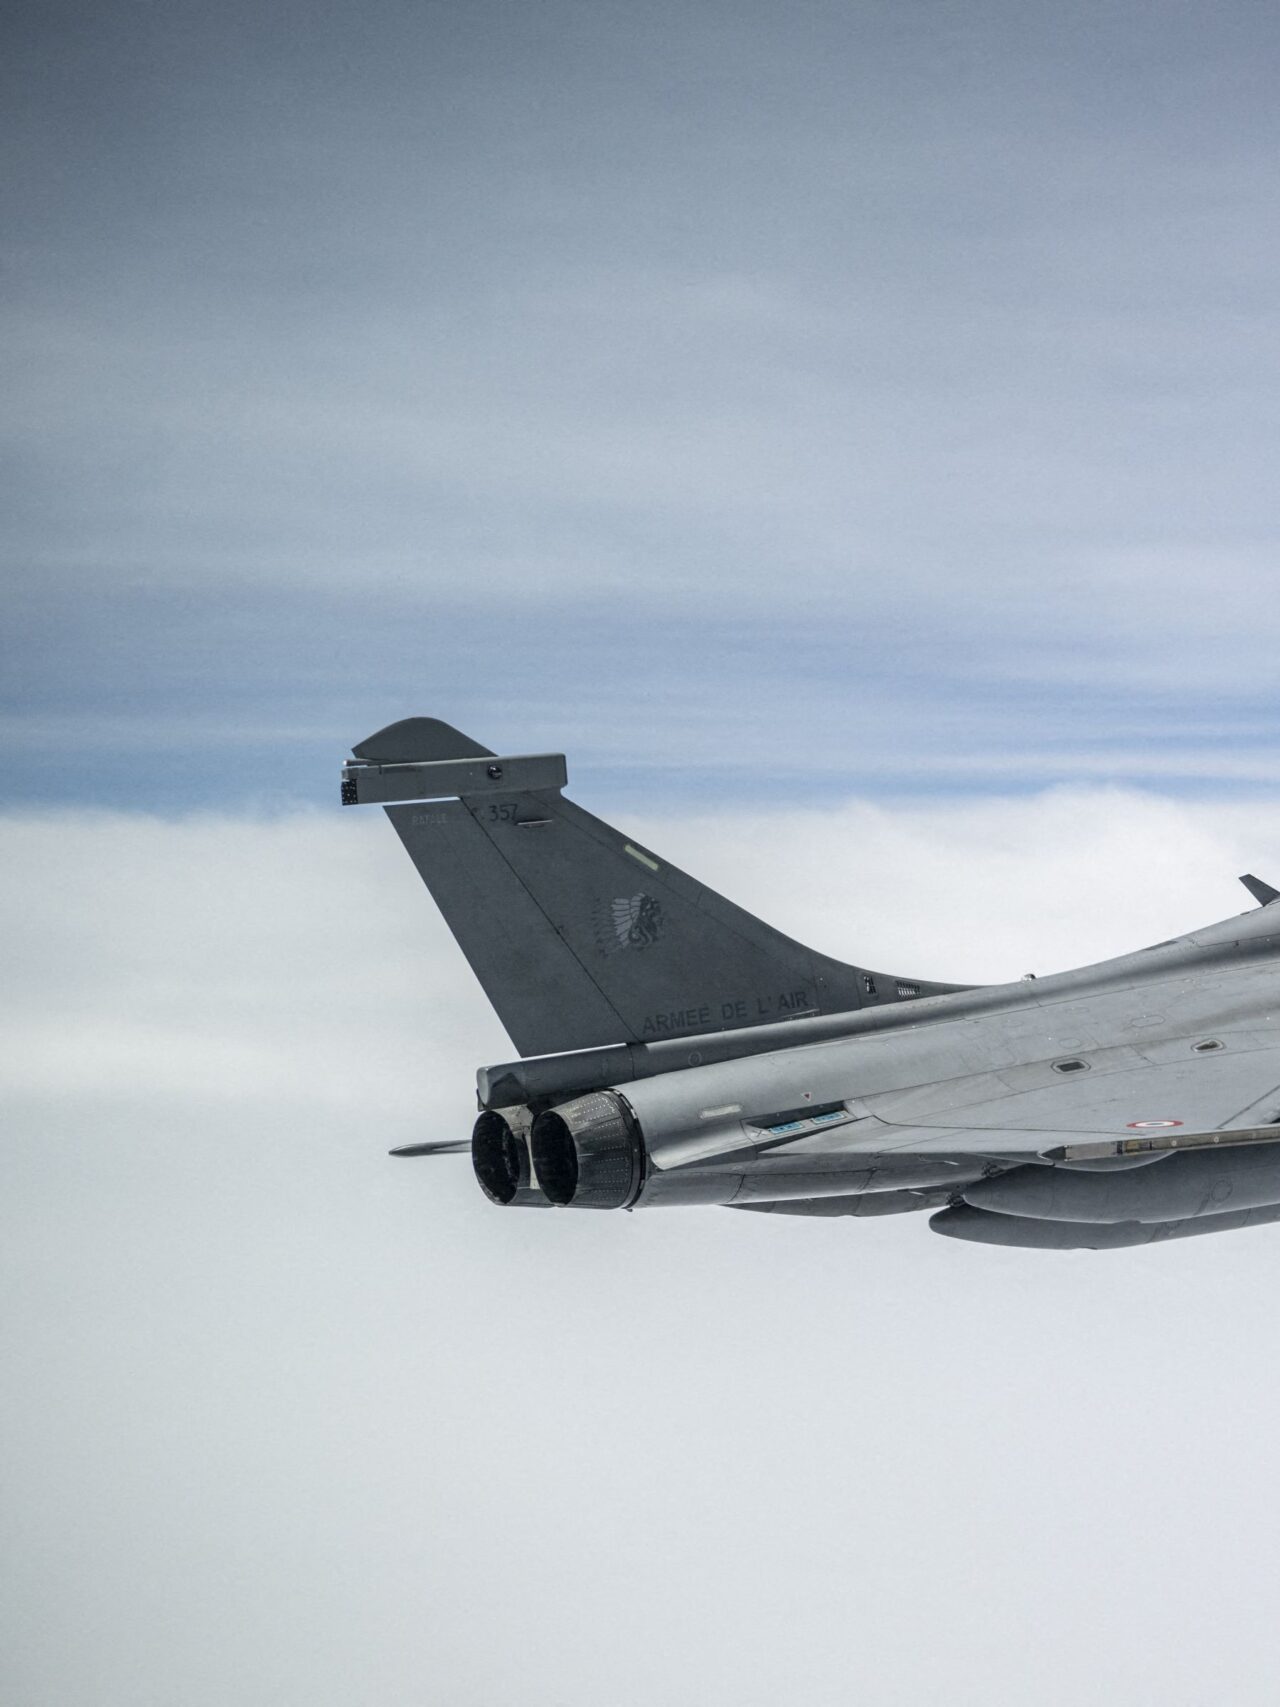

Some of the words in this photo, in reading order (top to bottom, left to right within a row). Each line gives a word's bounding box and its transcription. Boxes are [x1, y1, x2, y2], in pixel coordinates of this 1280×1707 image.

[487, 803, 518, 822] 357
[642, 1007, 711, 1034] ARMEE
[721, 1001, 747, 1020] DE
